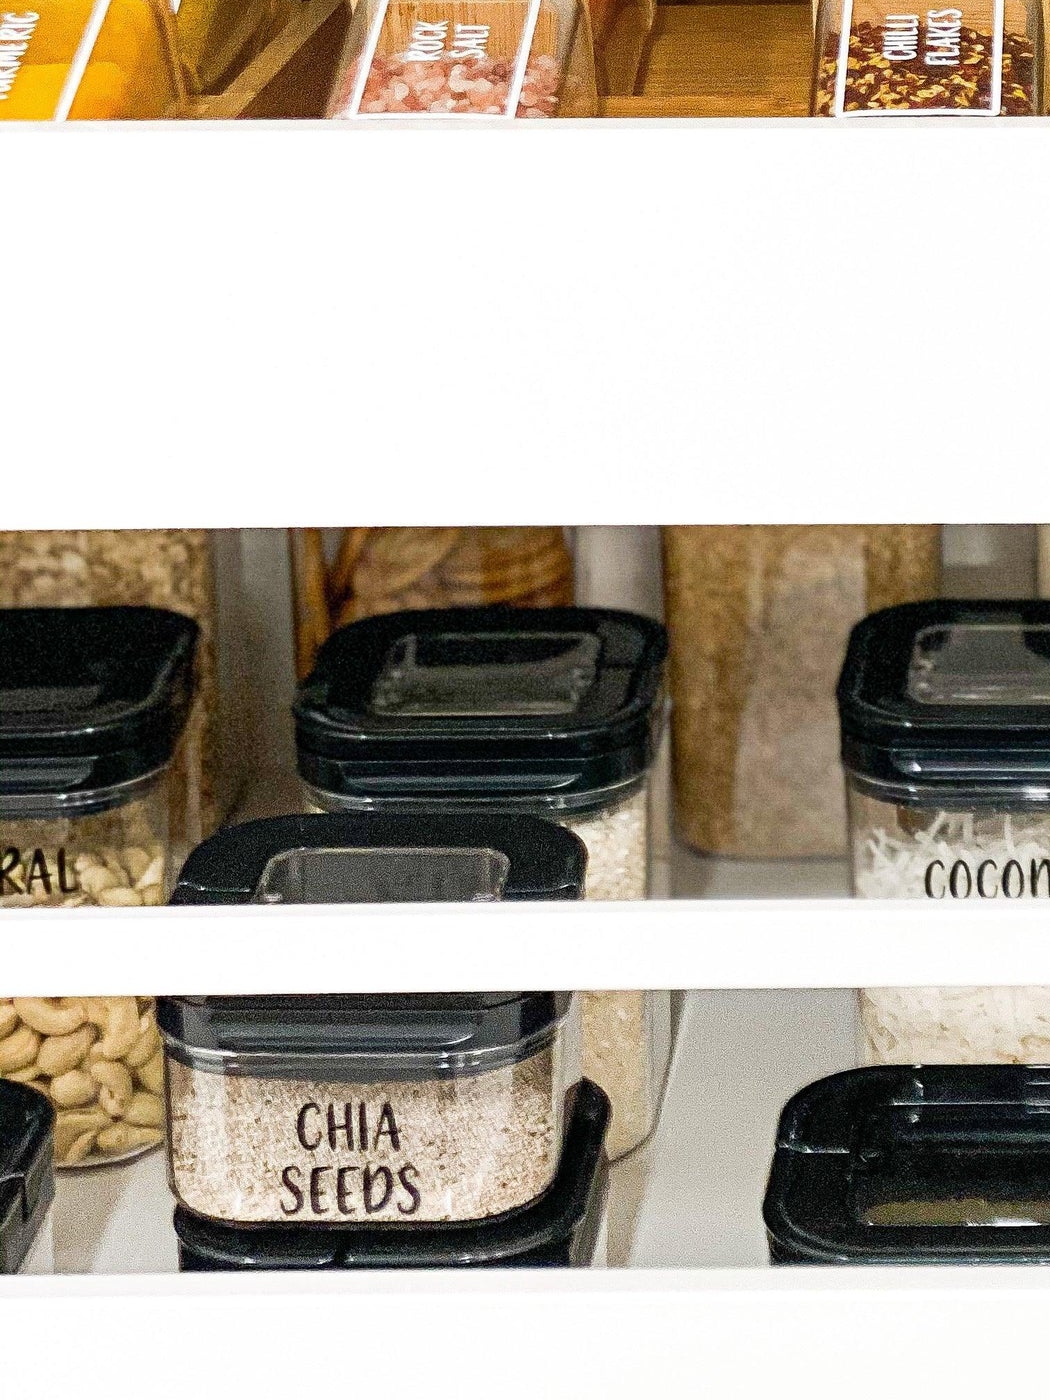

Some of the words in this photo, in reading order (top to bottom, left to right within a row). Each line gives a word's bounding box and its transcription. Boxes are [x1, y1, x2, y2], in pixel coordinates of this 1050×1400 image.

[406, 20, 449, 62] ROCK
[448, 23, 491, 59] SALT
[882, 13, 920, 62] CHILLI
[924, 8, 963, 66] FLAKES
[296, 1101, 402, 1151] CHIA
[279, 1163, 422, 1216] SEEDS
